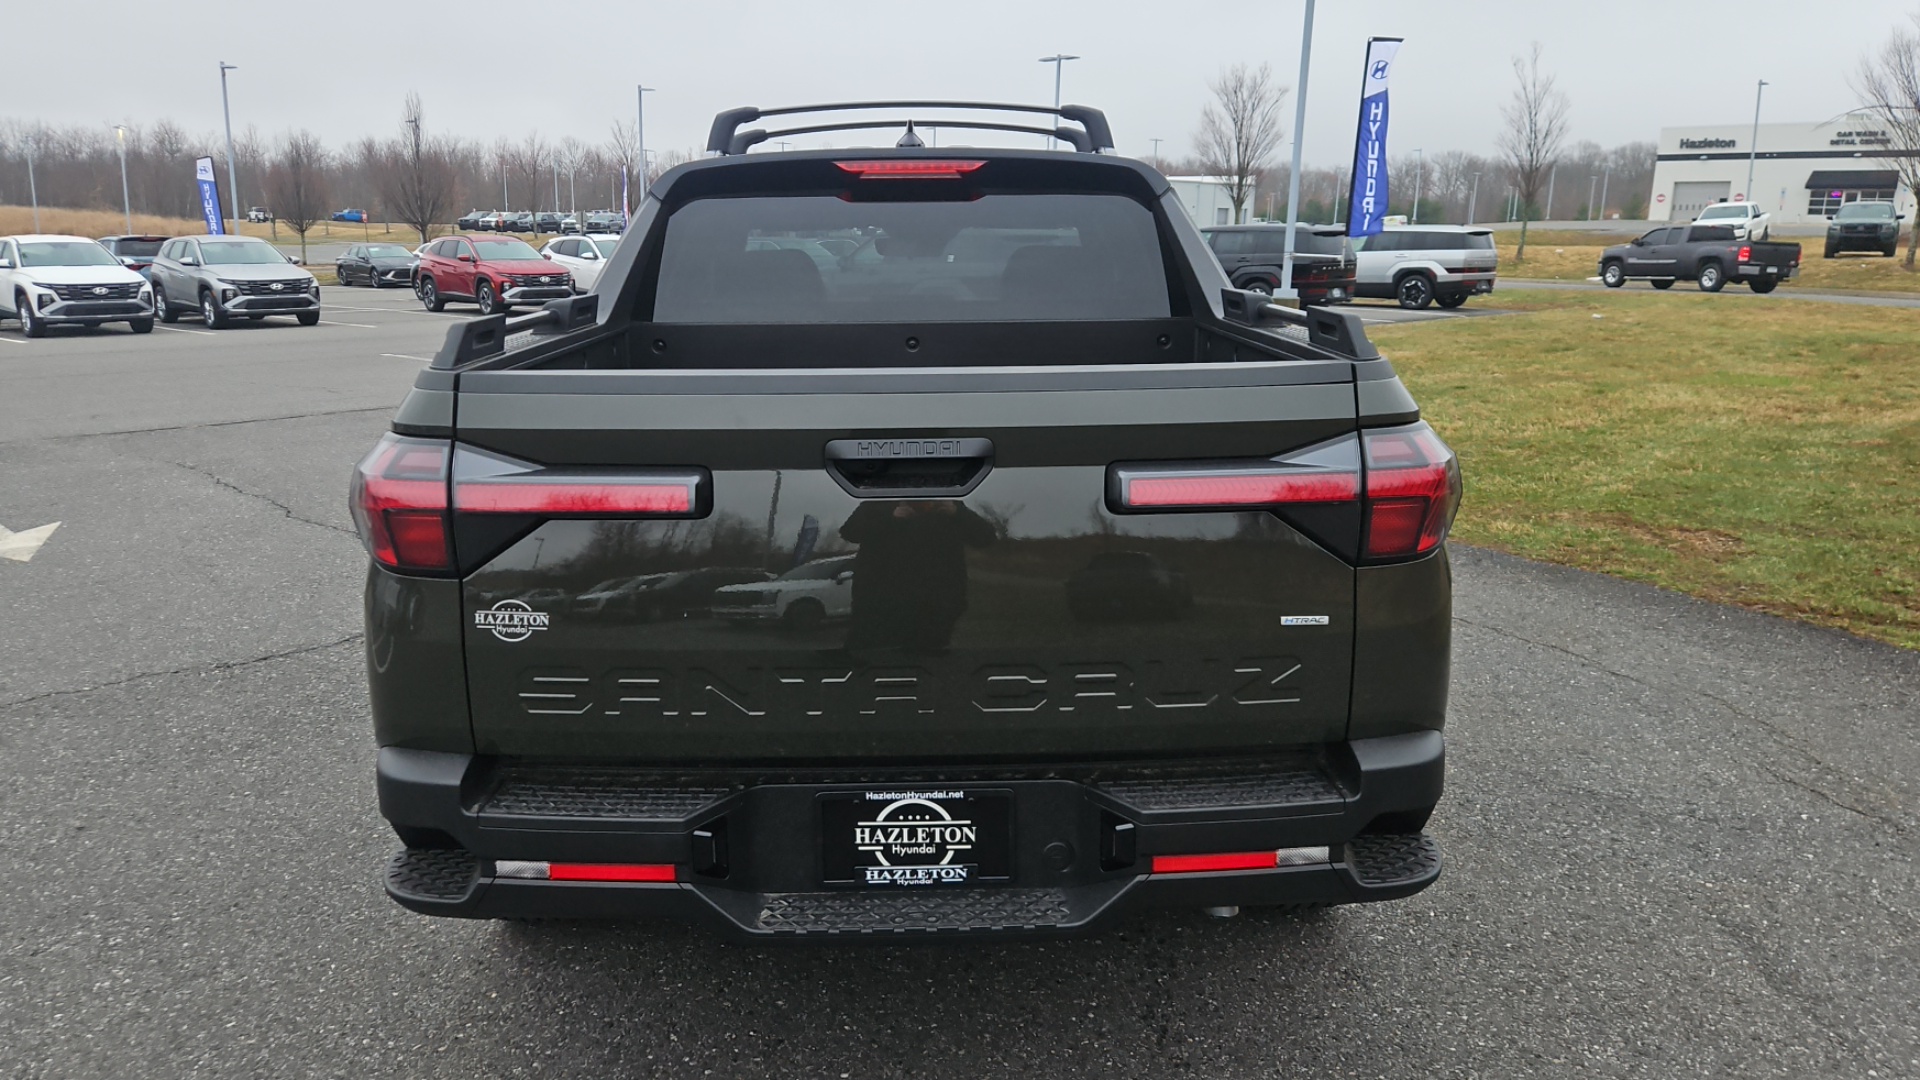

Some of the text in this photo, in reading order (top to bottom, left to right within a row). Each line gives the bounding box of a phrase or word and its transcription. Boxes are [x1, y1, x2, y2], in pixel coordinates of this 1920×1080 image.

[1679, 137, 1736, 149] Hazleton
[1362, 101, 1383, 231] HYUNDAI
[857, 440, 961, 457] HYUNDAI
[474, 613, 550, 626] HAZLETON
[495, 624, 528, 635] Hyundai
[517, 655, 1303, 715] SANTA CRUZ
[866, 791, 964, 800] HazletonHyundai.net
[854, 826, 977, 845] HAZLETON
[891, 843, 937, 857] Hyundai
[865, 868, 968, 881] HAZLETON
[896, 878, 934, 887] Hyundai
